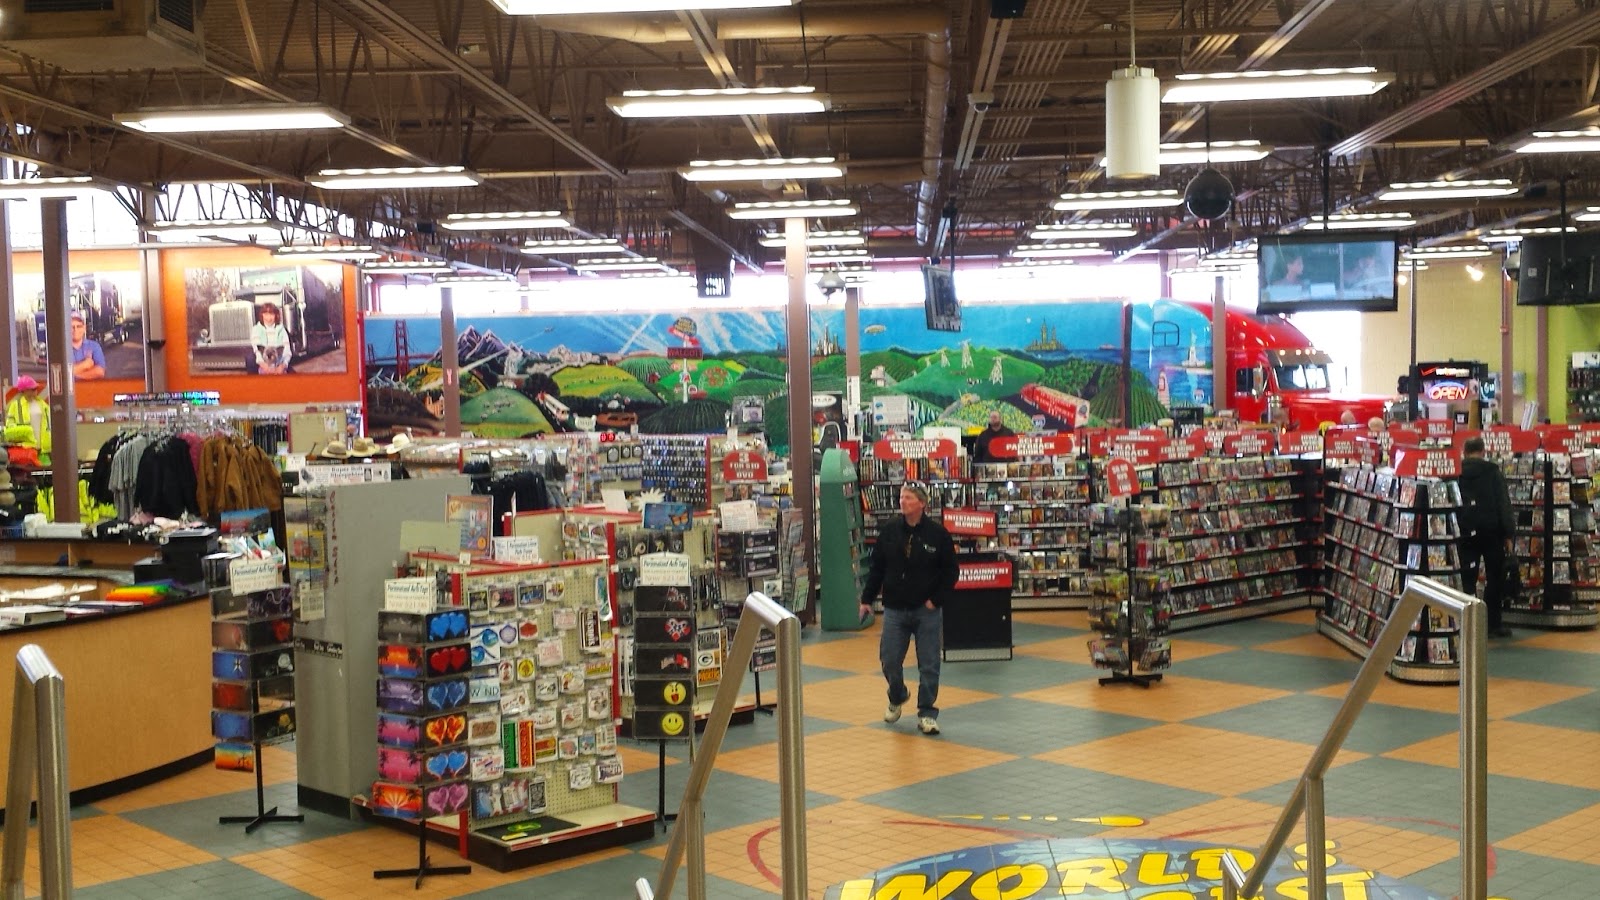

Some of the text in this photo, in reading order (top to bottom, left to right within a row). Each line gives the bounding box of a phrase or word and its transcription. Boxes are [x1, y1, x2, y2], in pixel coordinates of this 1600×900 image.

[1431, 386, 1468, 400] OPEN
[1006, 443, 1055, 451] PAPERBACK
[738, 452, 749, 462] 3
[736, 471, 754, 479] DVD
[1417, 466, 1456, 475] ON DVD
[944, 514, 994, 524] ENTERTAINMENT
[954, 520, 984, 529] BLOWOUT
[959, 567, 1009, 578] ERTAINMENT
